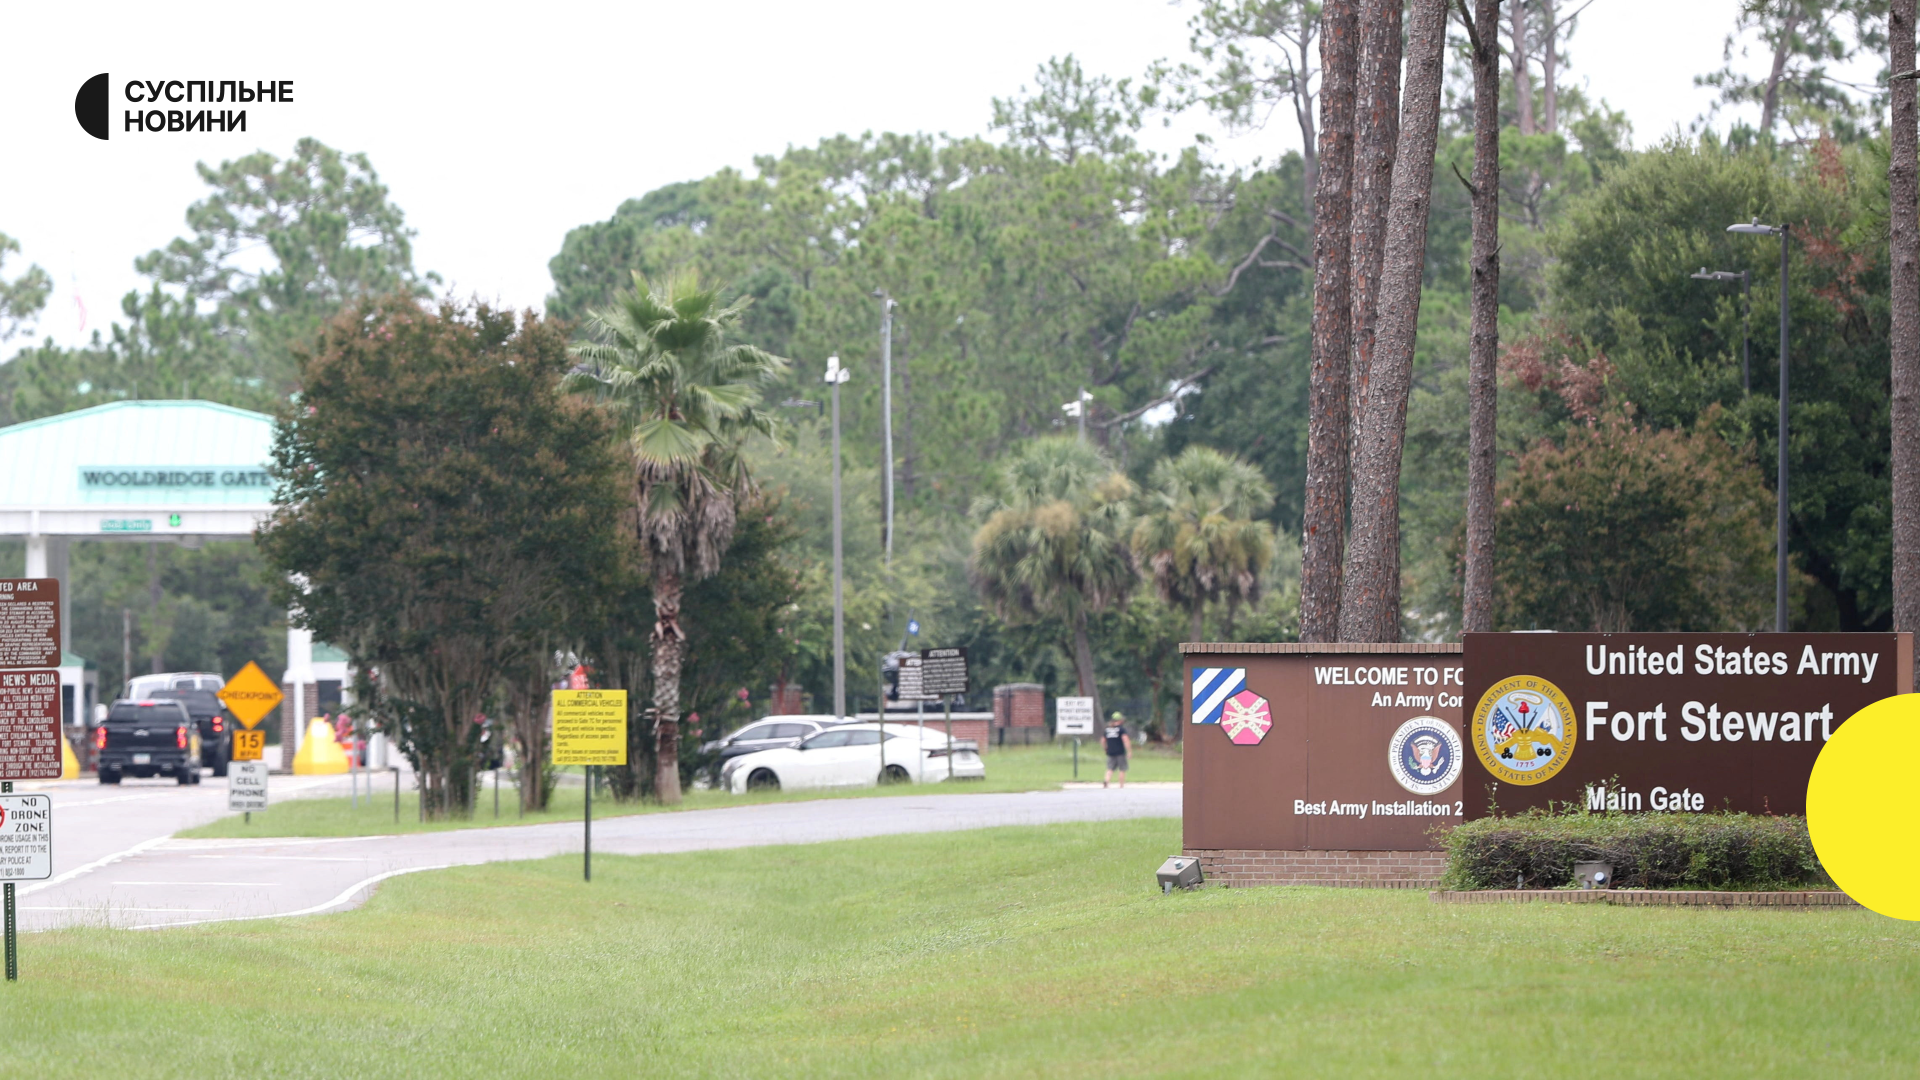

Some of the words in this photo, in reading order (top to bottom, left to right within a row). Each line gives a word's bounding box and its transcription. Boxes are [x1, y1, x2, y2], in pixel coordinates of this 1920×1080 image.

[84, 471, 214, 486] WOOLDRIDGE
[221, 472, 270, 486] GATE
[17, 582, 38, 591] AREA
[928, 649, 959, 658] ATTENTION
[1585, 644, 1684, 676] United
[1695, 644, 1788, 676] States
[1797, 644, 1879, 684] Army
[3, 674, 26, 686] NEWS
[1314, 666, 1408, 685] WELCOME
[1413, 667, 1438, 686] TO
[222, 691, 278, 700] CHECKPOINT
[1371, 692, 1392, 707] An
[1395, 692, 1434, 711] Army
[1477, 680, 1521, 725] DEPARTMENT
[1542, 685, 1558, 700] THE
[1557, 701, 1572, 727] ARMY
[1586, 701, 1667, 742] Fort
[1680, 701, 1834, 742] Stewart
[240, 734, 259, 748] 15
[1392, 720, 1424, 753] PRESIDENT
[1446, 729, 1461, 761] UNITED
[1477, 734, 1497, 768] UNITED
[1498, 767, 1533, 781] STATES
[1535, 770, 1547, 779] OF
[1548, 733, 1572, 772] AMERICA
[1432, 768, 1457, 790] STATES
[22, 798, 37, 807] NO
[1586, 786, 1642, 811] Main
[1650, 786, 1704, 811] Gate
[11, 810, 48, 820] DRONE
[1294, 800, 1326, 815] Best
[1329, 800, 1368, 819] Army
[1372, 800, 1450, 816] Installation
[1454, 801, 1463, 816] 2
[15, 823, 44, 832] ZONE
[15, 834, 31, 842] USAGE
[32, 834, 37, 842] IN
[38, 834, 48, 842] THIS
[5, 845, 24, 853] REPORT
[25, 845, 29, 853] IT
[30, 845, 37, 853] TO
[38, 845, 47, 853] THE
[8, 856, 25, 864] POLICE
[26, 856, 32, 864] AT
